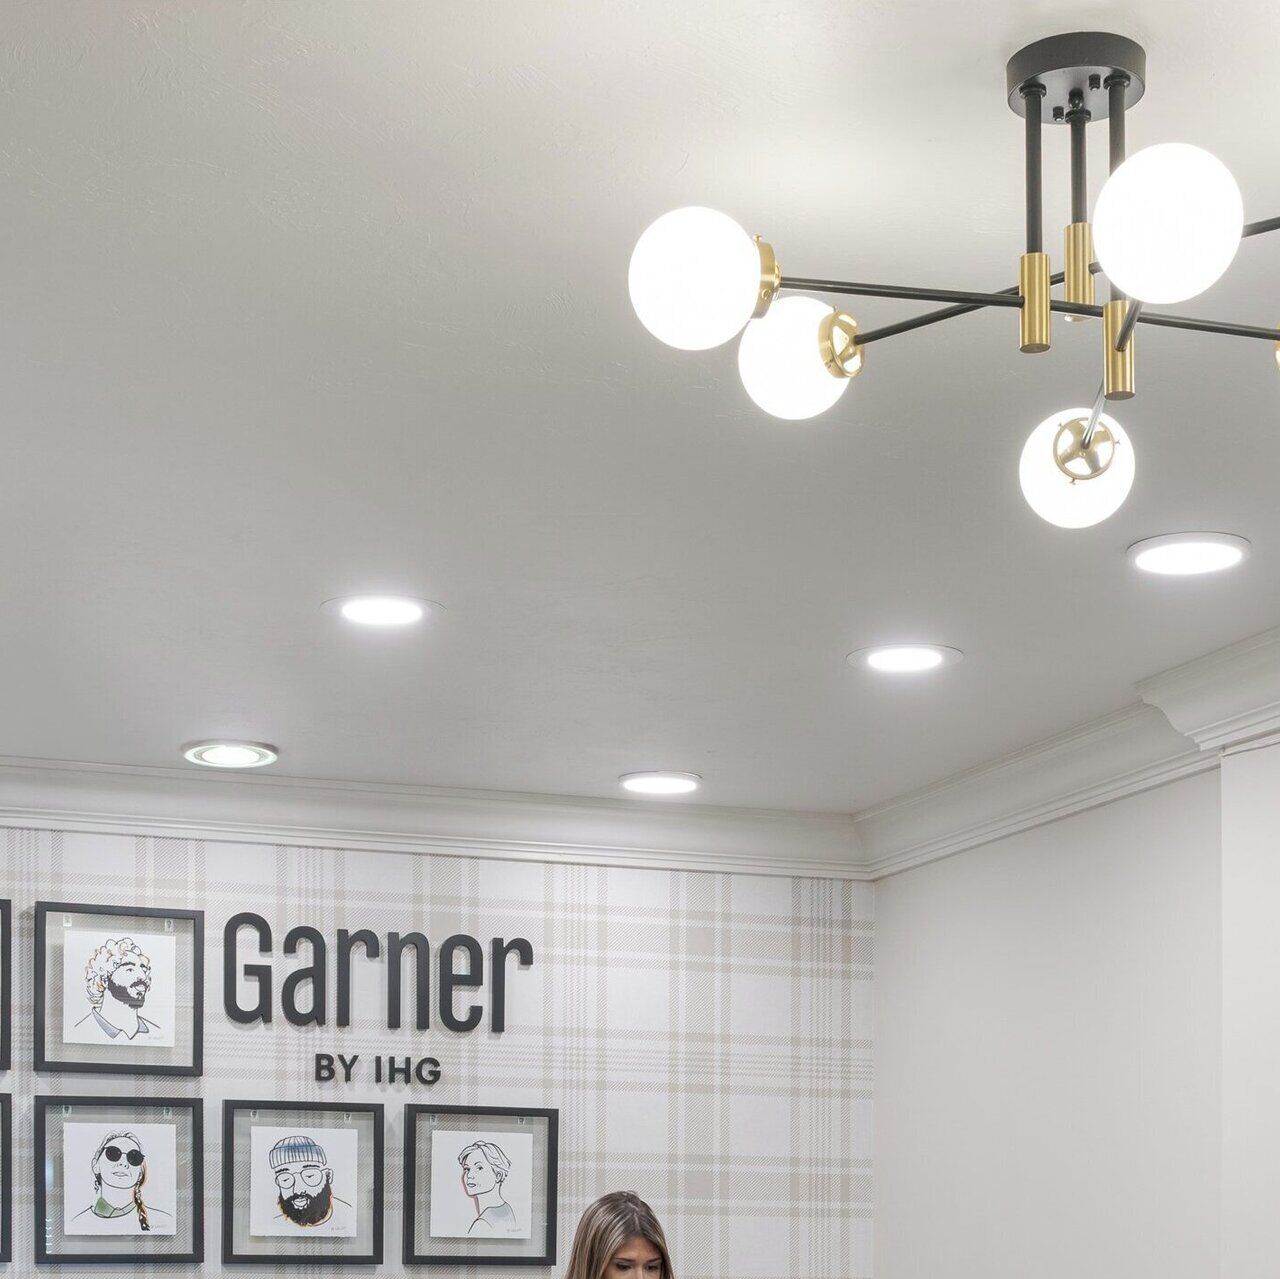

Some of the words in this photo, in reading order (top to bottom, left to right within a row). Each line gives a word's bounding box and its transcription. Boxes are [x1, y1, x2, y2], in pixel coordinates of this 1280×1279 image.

[223, 912, 534, 1033] Garner
[315, 1053, 359, 1083] BY
[375, 1055, 441, 1085] IHG
